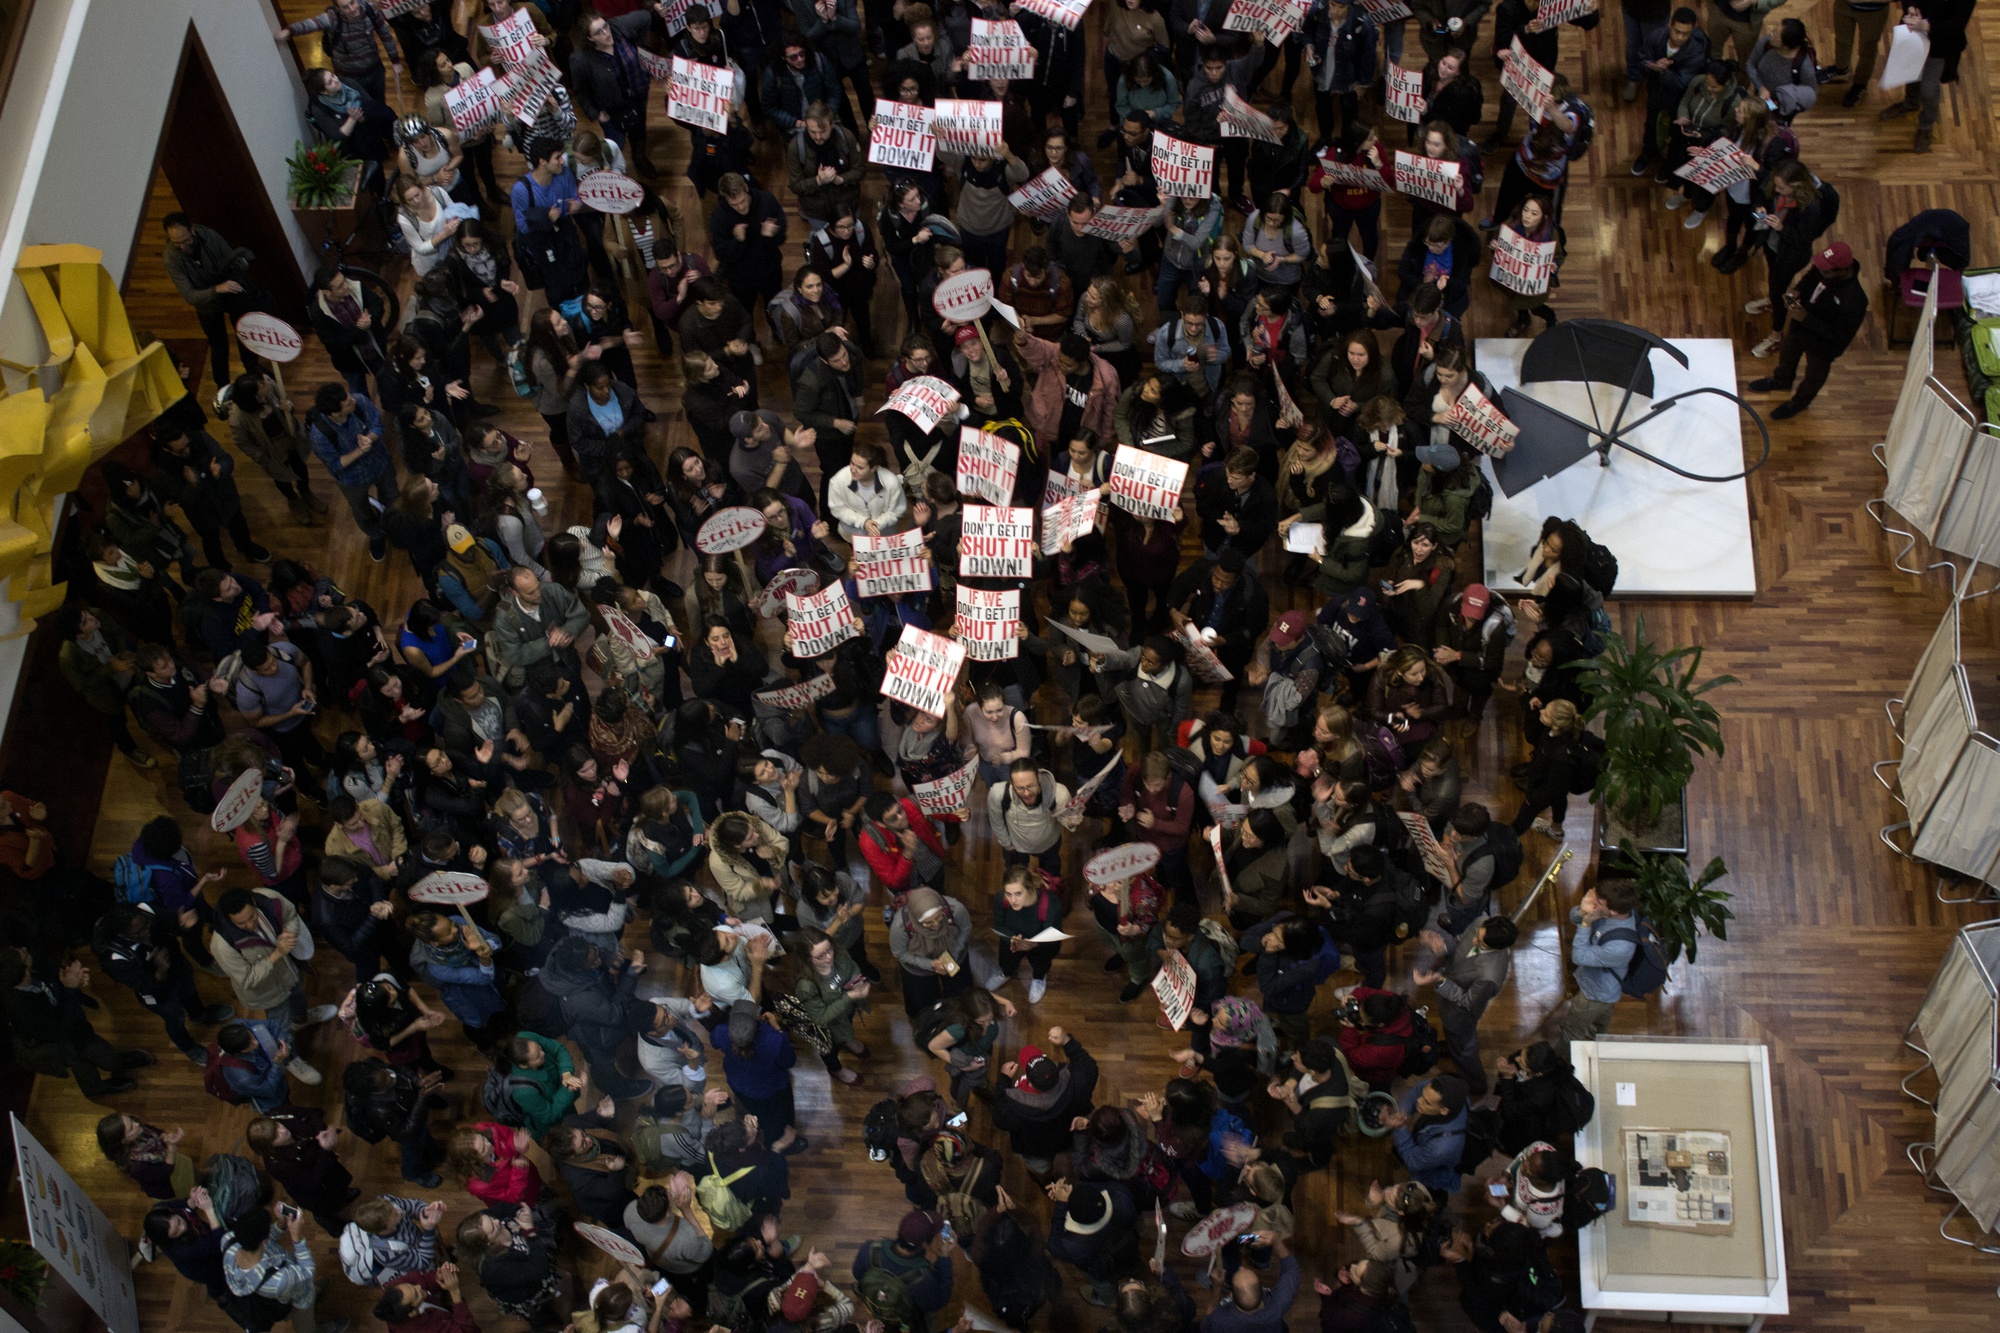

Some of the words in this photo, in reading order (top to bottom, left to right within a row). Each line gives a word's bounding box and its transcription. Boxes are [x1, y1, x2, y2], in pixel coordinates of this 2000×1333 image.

[490, 25, 500, 37] IF
[503, 17, 519, 33] WE
[1230, 0, 1275, 22] SHUT
[1274, 18, 1293, 35] IT
[1543, 4, 1587, 27] DOWN!
[510, 27, 525, 43] GET
[525, 21, 534, 32] IT
[986, 21, 998, 35] IF
[1002, 21, 1018, 35] WE
[972, 34, 999, 46] DON'T
[1003, 36, 1022, 46] GET
[970, 48, 1012, 64] SHUT
[687, 60, 697, 75] IF
[700, 65, 717, 82] WE
[975, 64, 1026, 79] DOWN!
[456, 83, 467, 99] IF
[468, 73, 483, 91] WE
[1393, 78, 1410, 92] GET
[1412, 83, 1421, 94] IT
[450, 95, 476, 116] DON'T
[475, 86, 491, 102] GET
[669, 83, 709, 109] SHUT
[714, 98, 729, 117] IT
[892, 102, 903, 117] IF
[907, 104, 925, 120] WE
[953, 102, 963, 116] IF
[972, 101, 986, 116] WE
[454, 100, 490, 132] SHUT
[876, 113, 905, 129] DON'T
[907, 119, 926, 132] GET
[937, 116, 966, 129] DON'T
[990, 118, 1000, 130] IT
[872, 125, 916, 149] SHUT
[920, 135, 935, 153] IT
[1166, 137, 1177, 152] IF
[1180, 142, 1198, 158] WE
[876, 145, 926, 169] DOWN!
[1152, 145, 1178, 164] DON'T
[1180, 156, 1199, 169] GET
[1202, 160, 1212, 170] IT
[1411, 153, 1421, 168] IF
[1425, 157, 1443, 174] WE
[1152, 157, 1190, 183] SHUT
[1195, 169, 1211, 185] IT
[1396, 161, 1424, 176] DON'T
[1426, 170, 1444, 184] GET
[1692, 158, 1732, 185] SHUT
[579, 186, 643, 200] strike
[1156, 177, 1203, 197] DOWN!
[1396, 170, 1438, 190] SHUT
[1442, 179, 1457, 198] IT
[1404, 182, 1450, 207] DOWN!
[1090, 218, 1134, 233] SHUT
[1493, 249, 1532, 279] SHUT
[1536, 263, 1551, 280] IT
[1544, 253, 1553, 264] IT
[1497, 267, 1541, 294] DOWN!
[936, 284, 991, 310] strike
[237, 329, 302, 348] strike
[1475, 395, 1490, 410] IF
[1451, 403, 1492, 439] SHUT
[1485, 418, 1504, 435] GET
[978, 430, 989, 445] IF
[957, 455, 999, 483] SHUT
[1001, 470, 1018, 493] IT
[1114, 461, 1147, 482] DON'T
[1147, 471, 1170, 487] GET
[1169, 478, 1182, 492] IT
[1110, 475, 1157, 503] SHUT
[1159, 490, 1179, 510] IT
[980, 507, 991, 522] IF
[996, 507, 1015, 524] WE
[1116, 494, 1168, 520] DOWN!
[697, 518, 766, 548] strike
[963, 521, 995, 536] DON'T
[997, 524, 1018, 538] GET
[1021, 525, 1031, 538] IT
[871, 537, 882, 550] IF
[886, 534, 907, 549] WE
[891, 546, 910, 559] GET
[962, 535, 1008, 558] SHUT
[1014, 539, 1032, 559] IT
[856, 559, 903, 580] SHUT
[909, 556, 924, 573] IT
[969, 557, 1022, 576] DOWN!
[867, 574, 921, 594] DOWN!
[796, 596, 807, 611] IF
[810, 590, 831, 608] WE
[816, 601, 836, 618] GET
[837, 593, 847, 608] IT
[969, 590, 979, 605] IF
[983, 591, 1003, 607] WE
[958, 601, 982, 619] DON'T
[985, 607, 1006, 620] GET
[1009, 606, 1019, 619] IT
[789, 616, 832, 640] SHUT
[836, 605, 852, 627] IT
[956, 614, 996, 641] SHUT
[1003, 619, 1019, 640] IT
[1279, 621, 1290, 633] H
[798, 626, 851, 656] DOWN!
[962, 636, 1009, 660] DOWN!
[889, 653, 936, 687] SHUT
[936, 673, 955, 694] IT
[889, 677, 941, 713] DOWN!
[917, 786, 951, 800] DON'T
[953, 775, 971, 790] GET
[932, 778, 944, 789] IF
[948, 766, 967, 784] WE
[919, 787, 966, 808] SHUT
[409, 882, 486, 900] strike
[1156, 975, 1184, 1024] DOWN!
[1182, 989, 1194, 1012] IT
[794, 1287, 808, 1299] H
